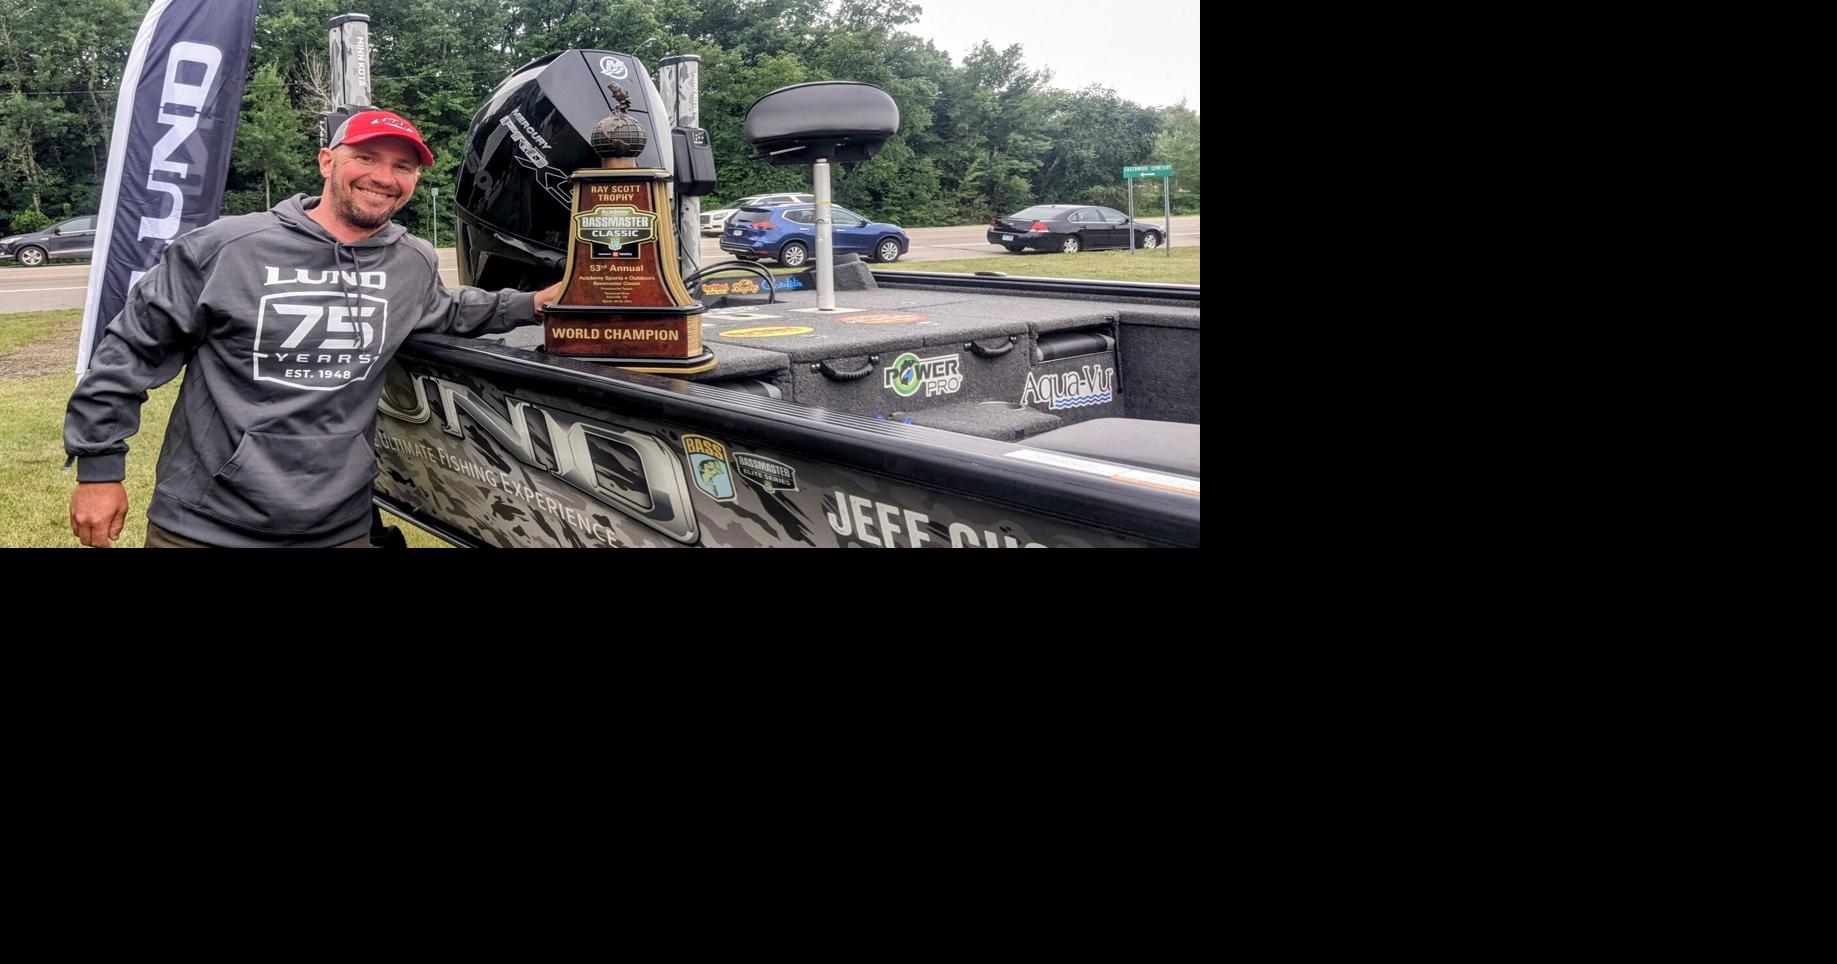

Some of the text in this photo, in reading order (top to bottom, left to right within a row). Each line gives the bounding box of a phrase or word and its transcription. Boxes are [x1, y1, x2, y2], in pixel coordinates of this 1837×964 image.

[356, 36, 366, 87] MINN KOTA
[510, 108, 553, 150] MERCURY
[499, 115, 549, 169] PRO
[127, 41, 223, 297] UND
[591, 185, 641, 193] RAY SCOTT
[598, 194, 634, 202] TROPHY
[582, 216, 649, 228] BASSMASTER
[264, 266, 387, 290] LUND
[609, 264, 644, 272] Annual
[272, 303, 377, 350] 75
[552, 328, 679, 341] WORLD CHAMPION
[275, 352, 371, 364] YEARS
[284, 369, 314, 379] EST.
[318, 369, 352, 380] 1948
[884, 353, 960, 397] POWER
[926, 376, 960, 398] PRO
[379, 369, 702, 546] UND
[685, 437, 725, 462] BASS
[738, 455, 792, 479] BASSMASTER
[827, 490, 931, 548] JEFF
